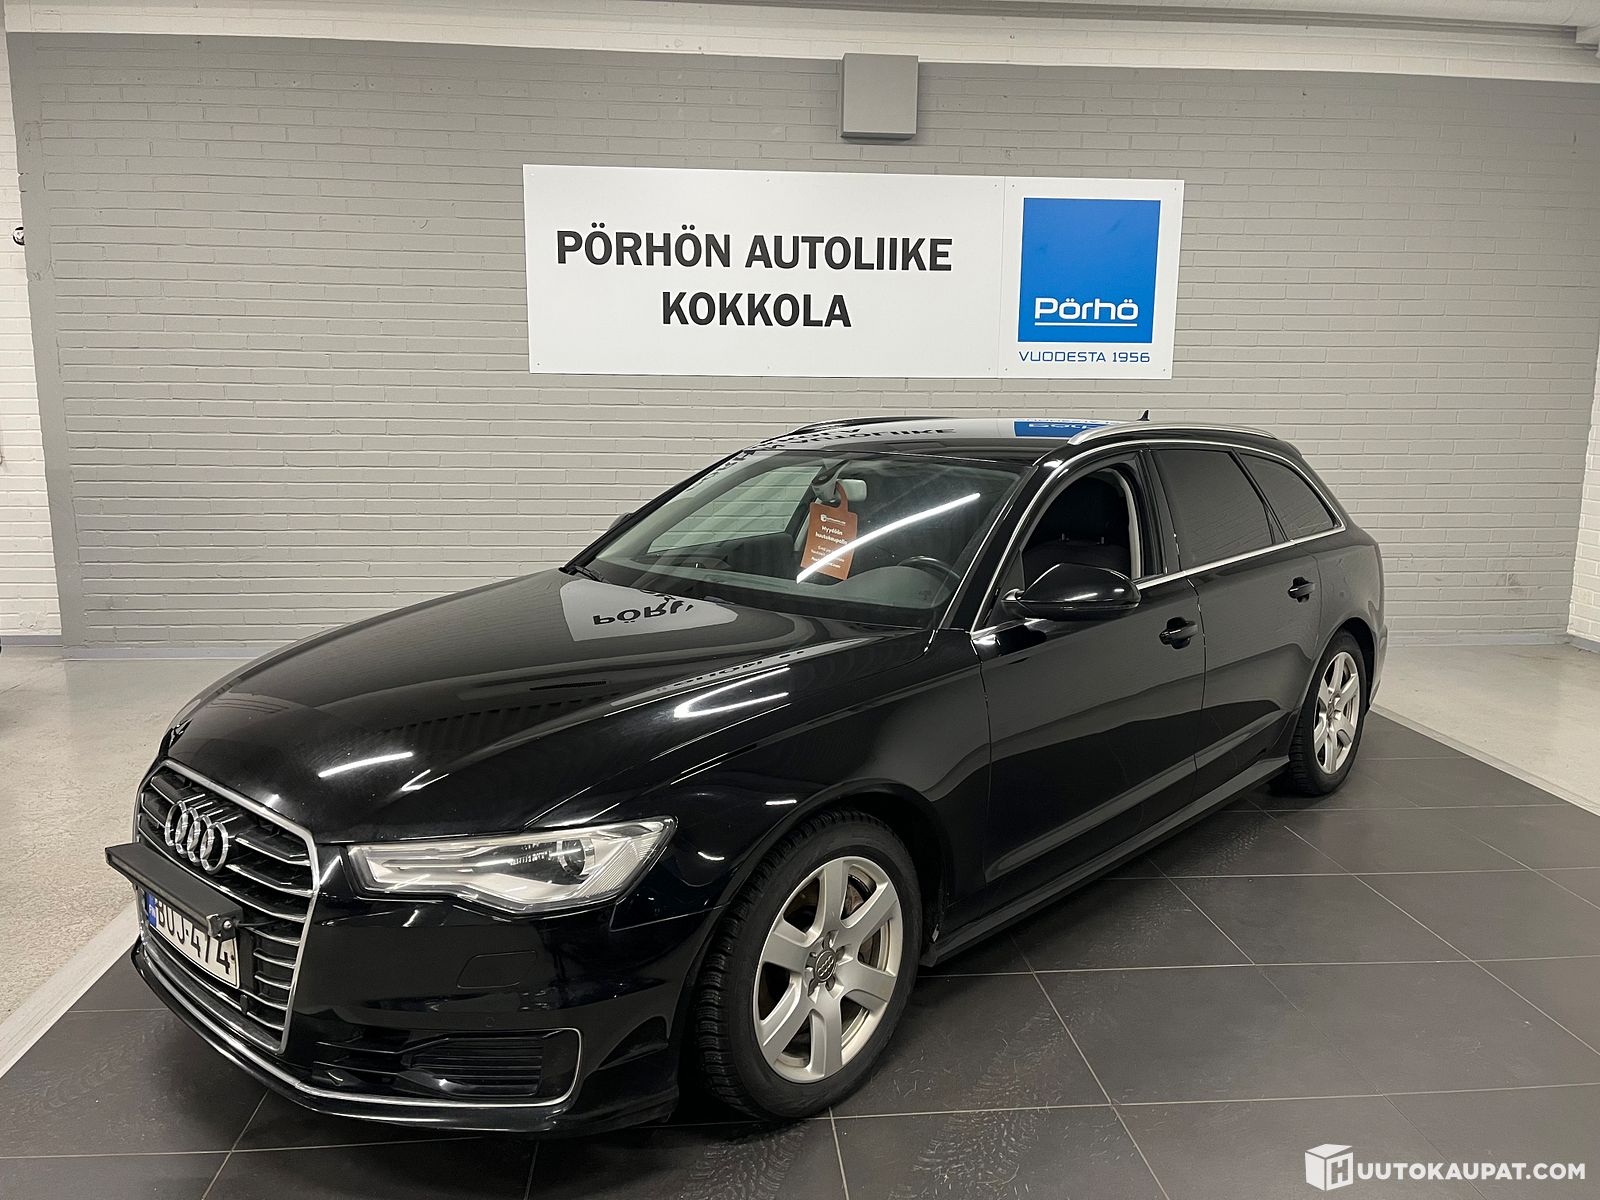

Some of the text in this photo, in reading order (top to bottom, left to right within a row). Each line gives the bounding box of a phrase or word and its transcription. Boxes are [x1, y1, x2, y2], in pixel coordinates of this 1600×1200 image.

[556, 222, 953, 272] PÖRHÖN AUTOLIIKE
[662, 291, 852, 328] KOKKOLA
[1034, 297, 1139, 321] Pörhö
[1018, 351, 1151, 363] VUODESTA 1956
